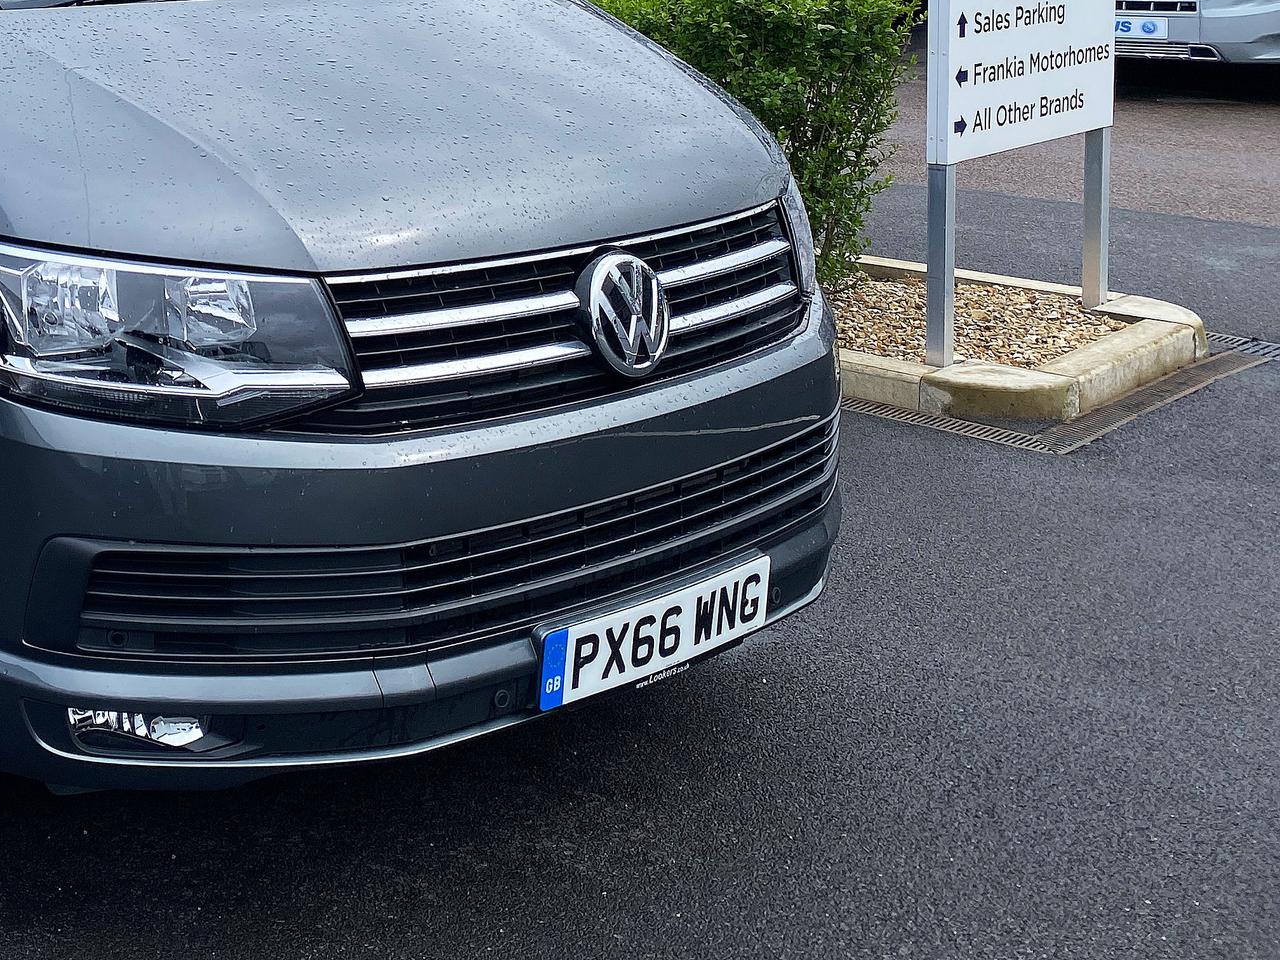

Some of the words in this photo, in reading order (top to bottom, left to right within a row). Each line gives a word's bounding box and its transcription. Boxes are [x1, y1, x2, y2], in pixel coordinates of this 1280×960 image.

[973, 10, 1011, 34] Sales
[1015, 1, 1066, 28] Parking
[973, 56, 1025, 86] Frankia
[1029, 42, 1110, 75] Motorhomes
[972, 107, 991, 133] All
[996, 98, 1036, 125] Other
[1039, 89, 1084, 117] Brands
[571, 604, 683, 690] PX66
[694, 573, 761, 646] WNG
[545, 675, 561, 694] GB
